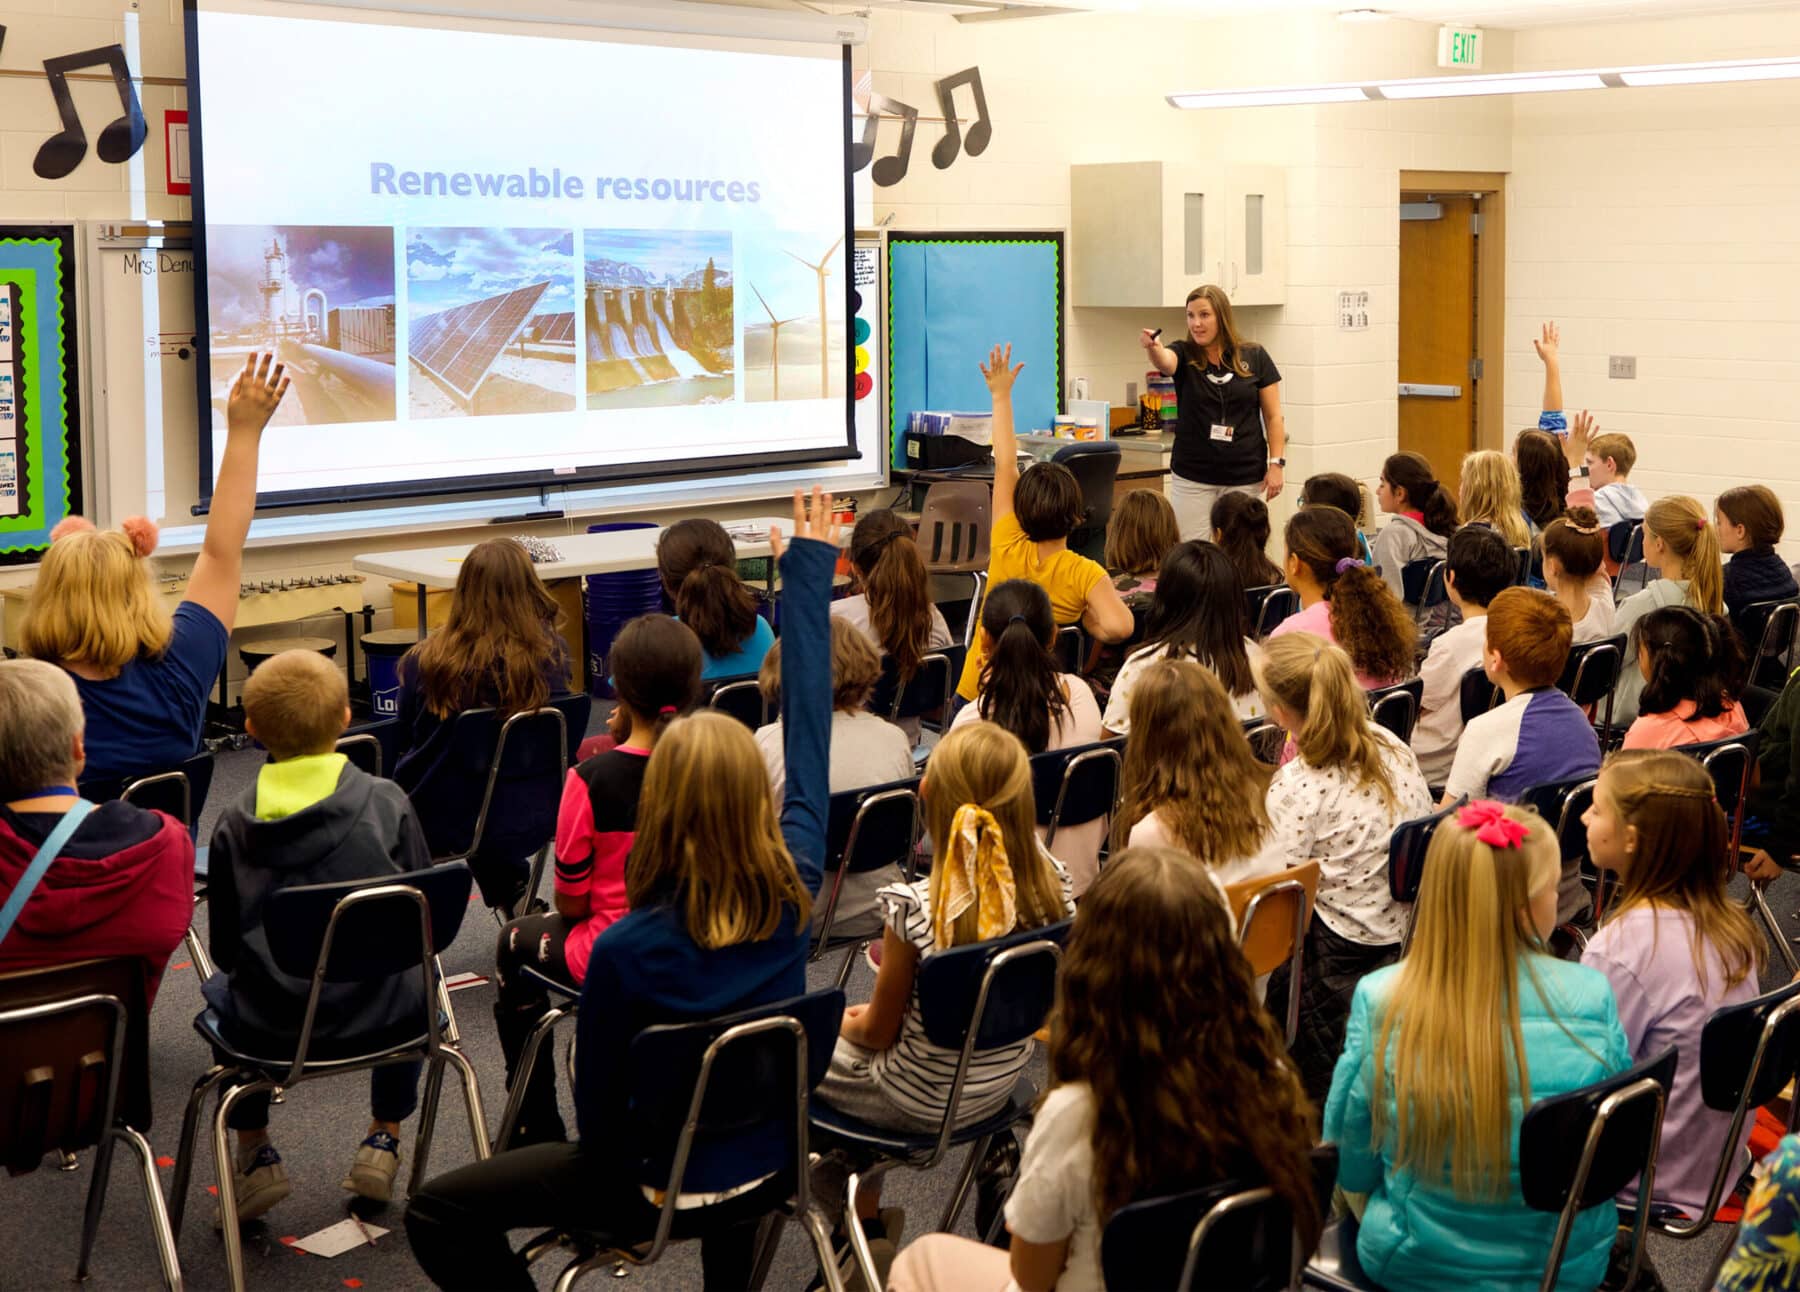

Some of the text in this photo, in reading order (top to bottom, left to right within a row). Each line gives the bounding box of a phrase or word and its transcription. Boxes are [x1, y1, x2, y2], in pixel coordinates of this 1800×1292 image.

[1452, 32, 1477, 64] EXIT
[369, 162, 761, 202] Renewable resources
[123, 253, 156, 275] Mrs.
